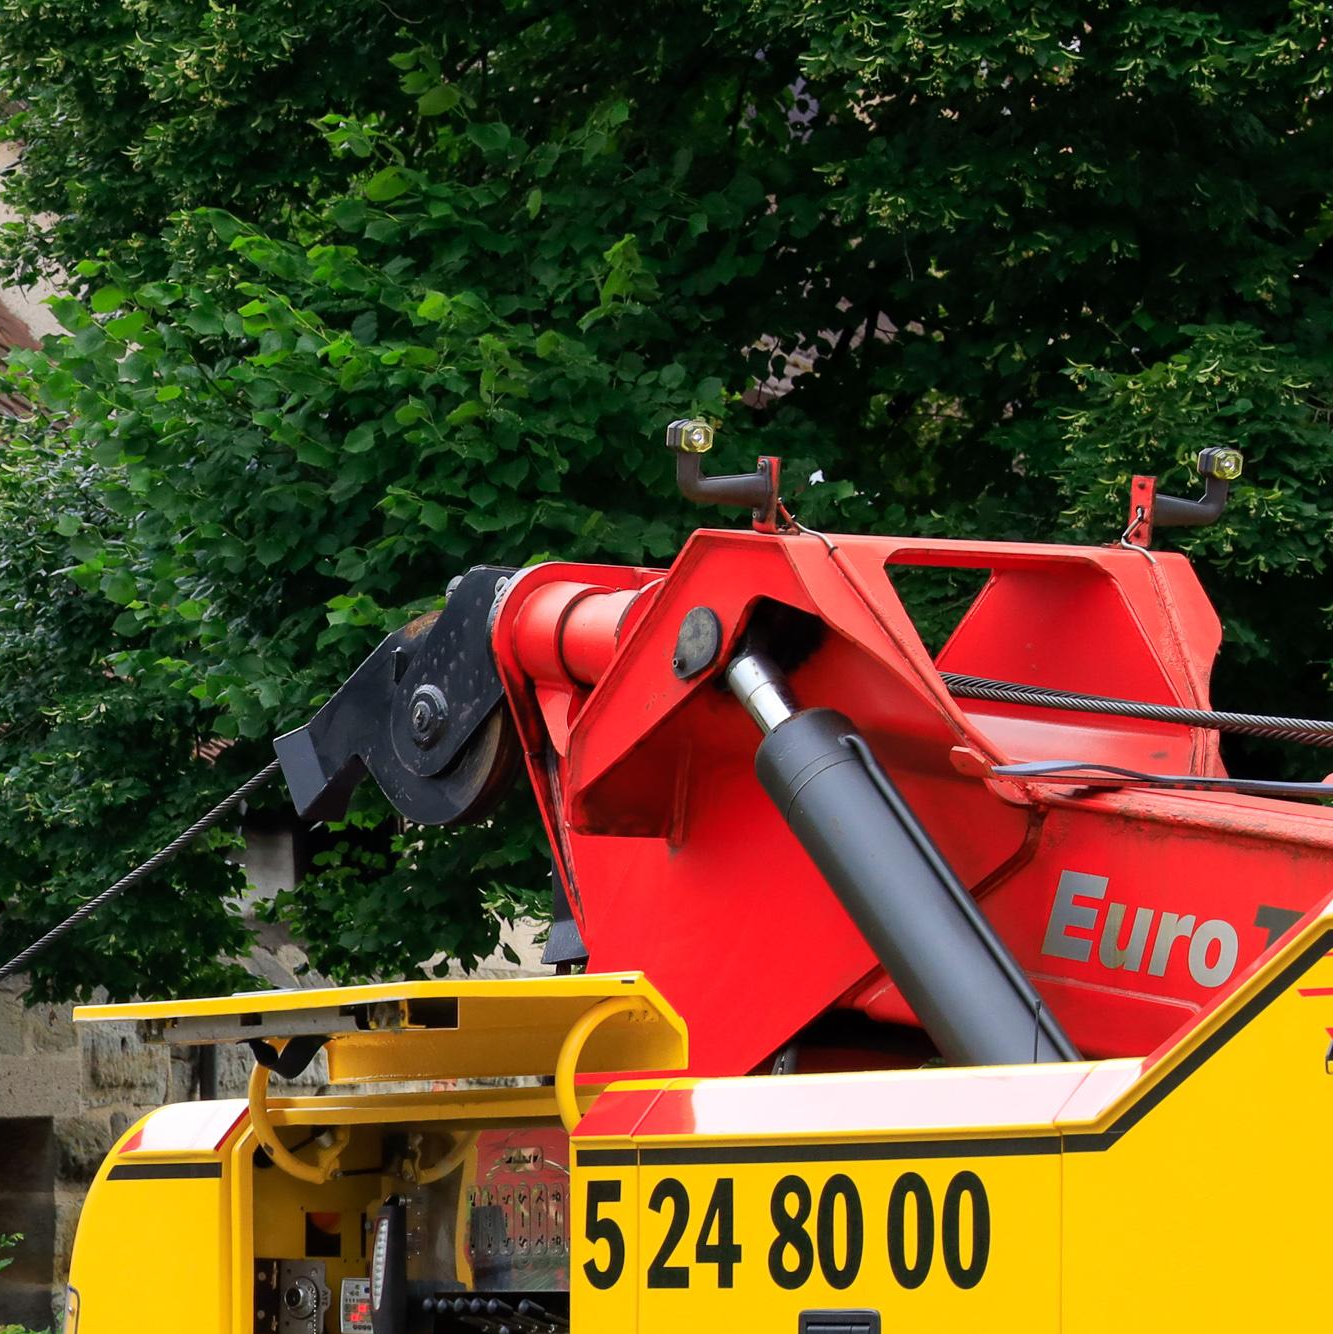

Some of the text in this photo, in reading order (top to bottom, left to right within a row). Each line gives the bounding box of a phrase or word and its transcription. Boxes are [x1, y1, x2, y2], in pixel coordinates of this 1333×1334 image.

[1041, 869, 1239, 988] Euro
[582, 1170, 991, 1290] 5 24 80 00
